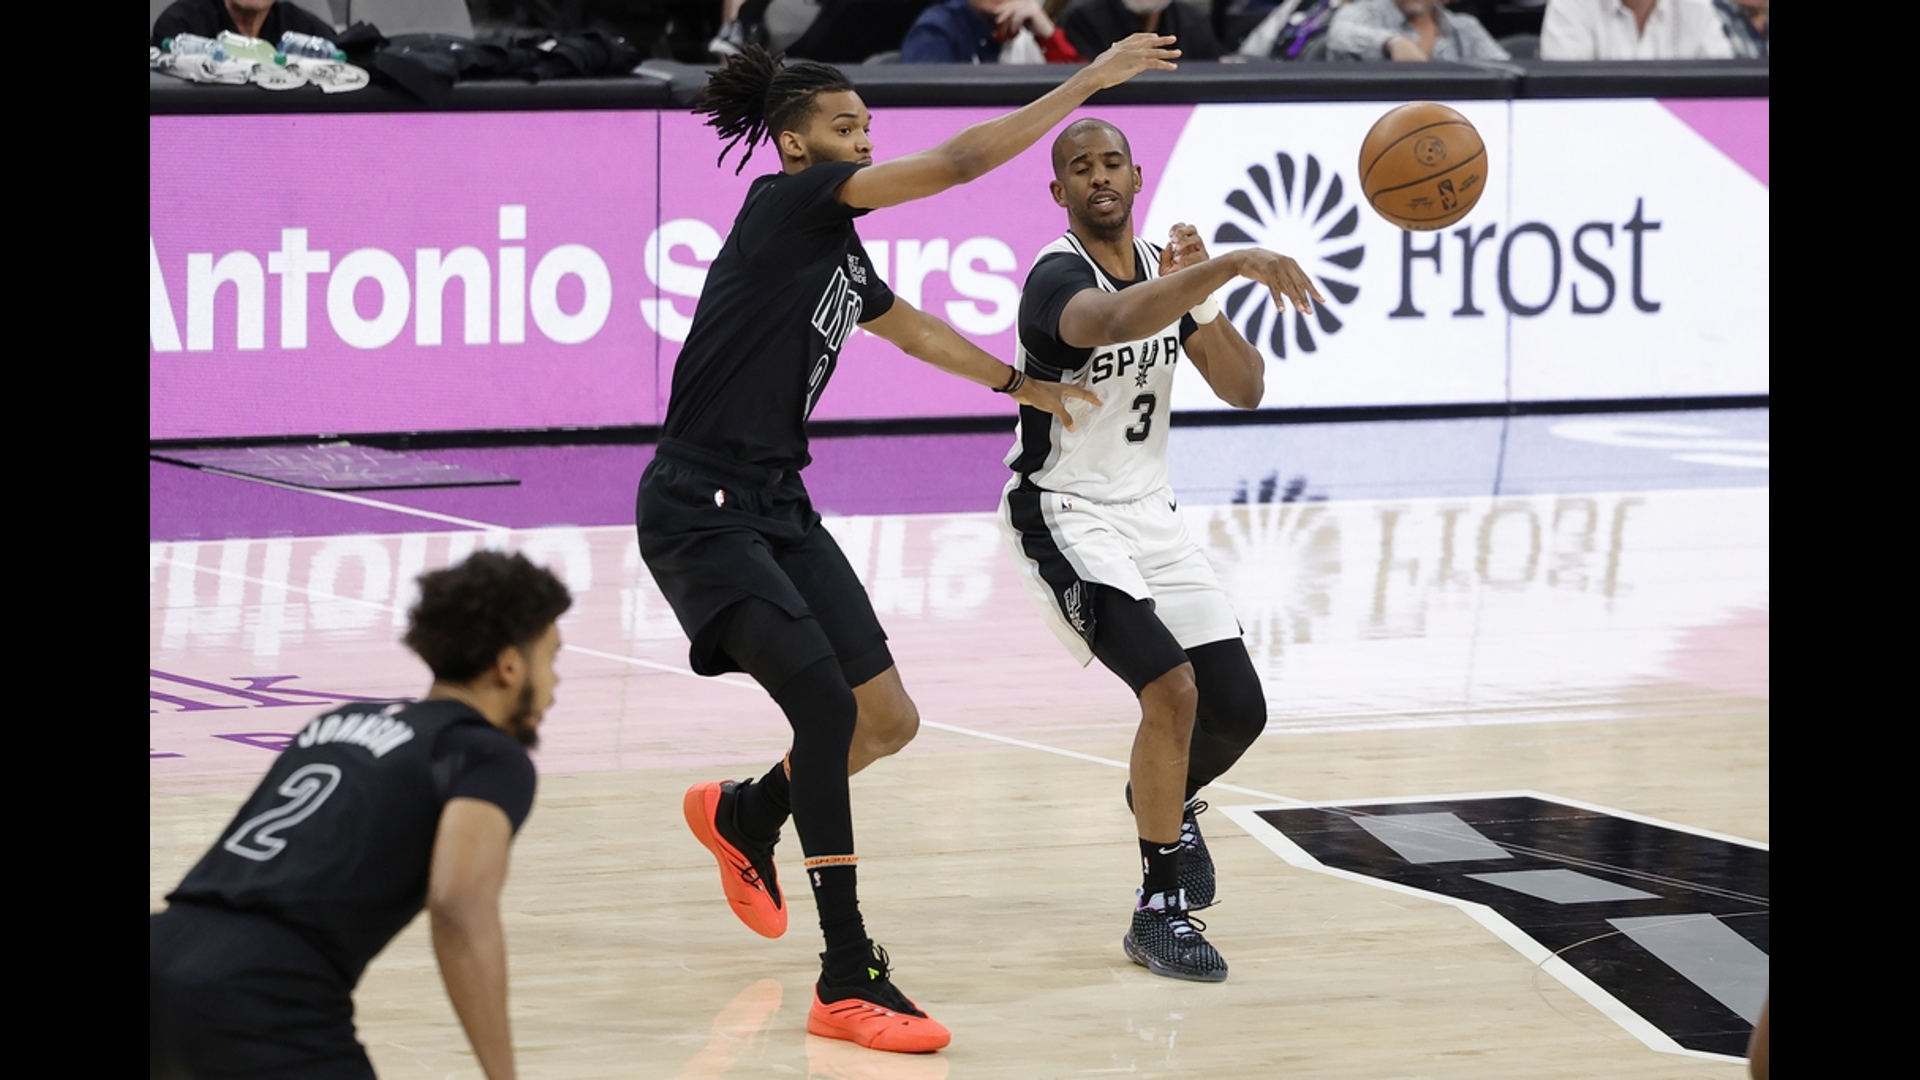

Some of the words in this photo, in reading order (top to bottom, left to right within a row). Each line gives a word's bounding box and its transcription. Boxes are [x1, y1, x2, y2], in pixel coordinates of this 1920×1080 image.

[640, 217, 1018, 344] Srs
[1388, 196, 1662, 319] Frost
[1092, 336, 1179, 388] SPUR
[1123, 390, 1157, 446] 3
[223, 763, 342, 861] 2
